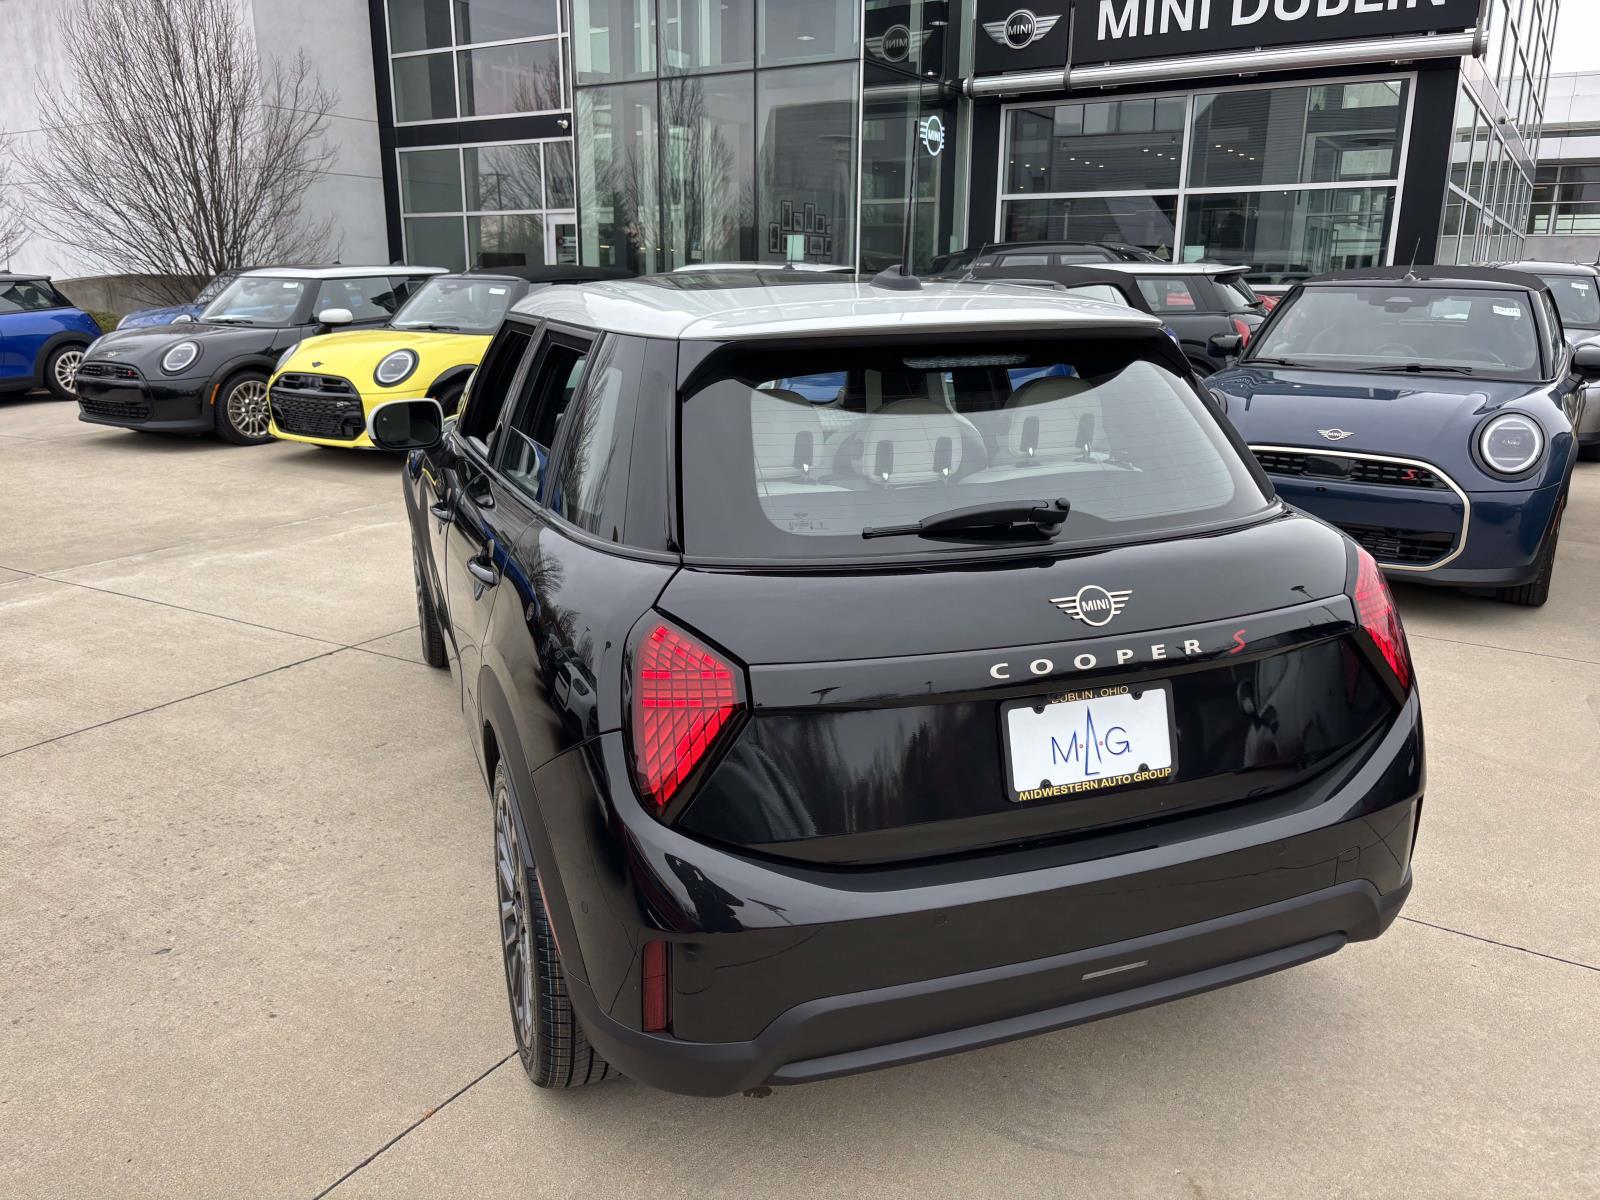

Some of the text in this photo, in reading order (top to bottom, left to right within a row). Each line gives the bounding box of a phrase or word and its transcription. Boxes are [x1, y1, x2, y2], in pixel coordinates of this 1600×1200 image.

[1097, 0, 1211, 41] MINI
[1008, 23, 1032, 35] MINI
[927, 131, 941, 142] MINI
[1401, 468, 1418, 480] S
[1081, 598, 1110, 613] MINI
[989, 629, 1247, 680] COOPER S
[1100, 685, 1129, 697] OHIO
[1019, 767, 1172, 801] MIDWESTERN AUTO GROUP
